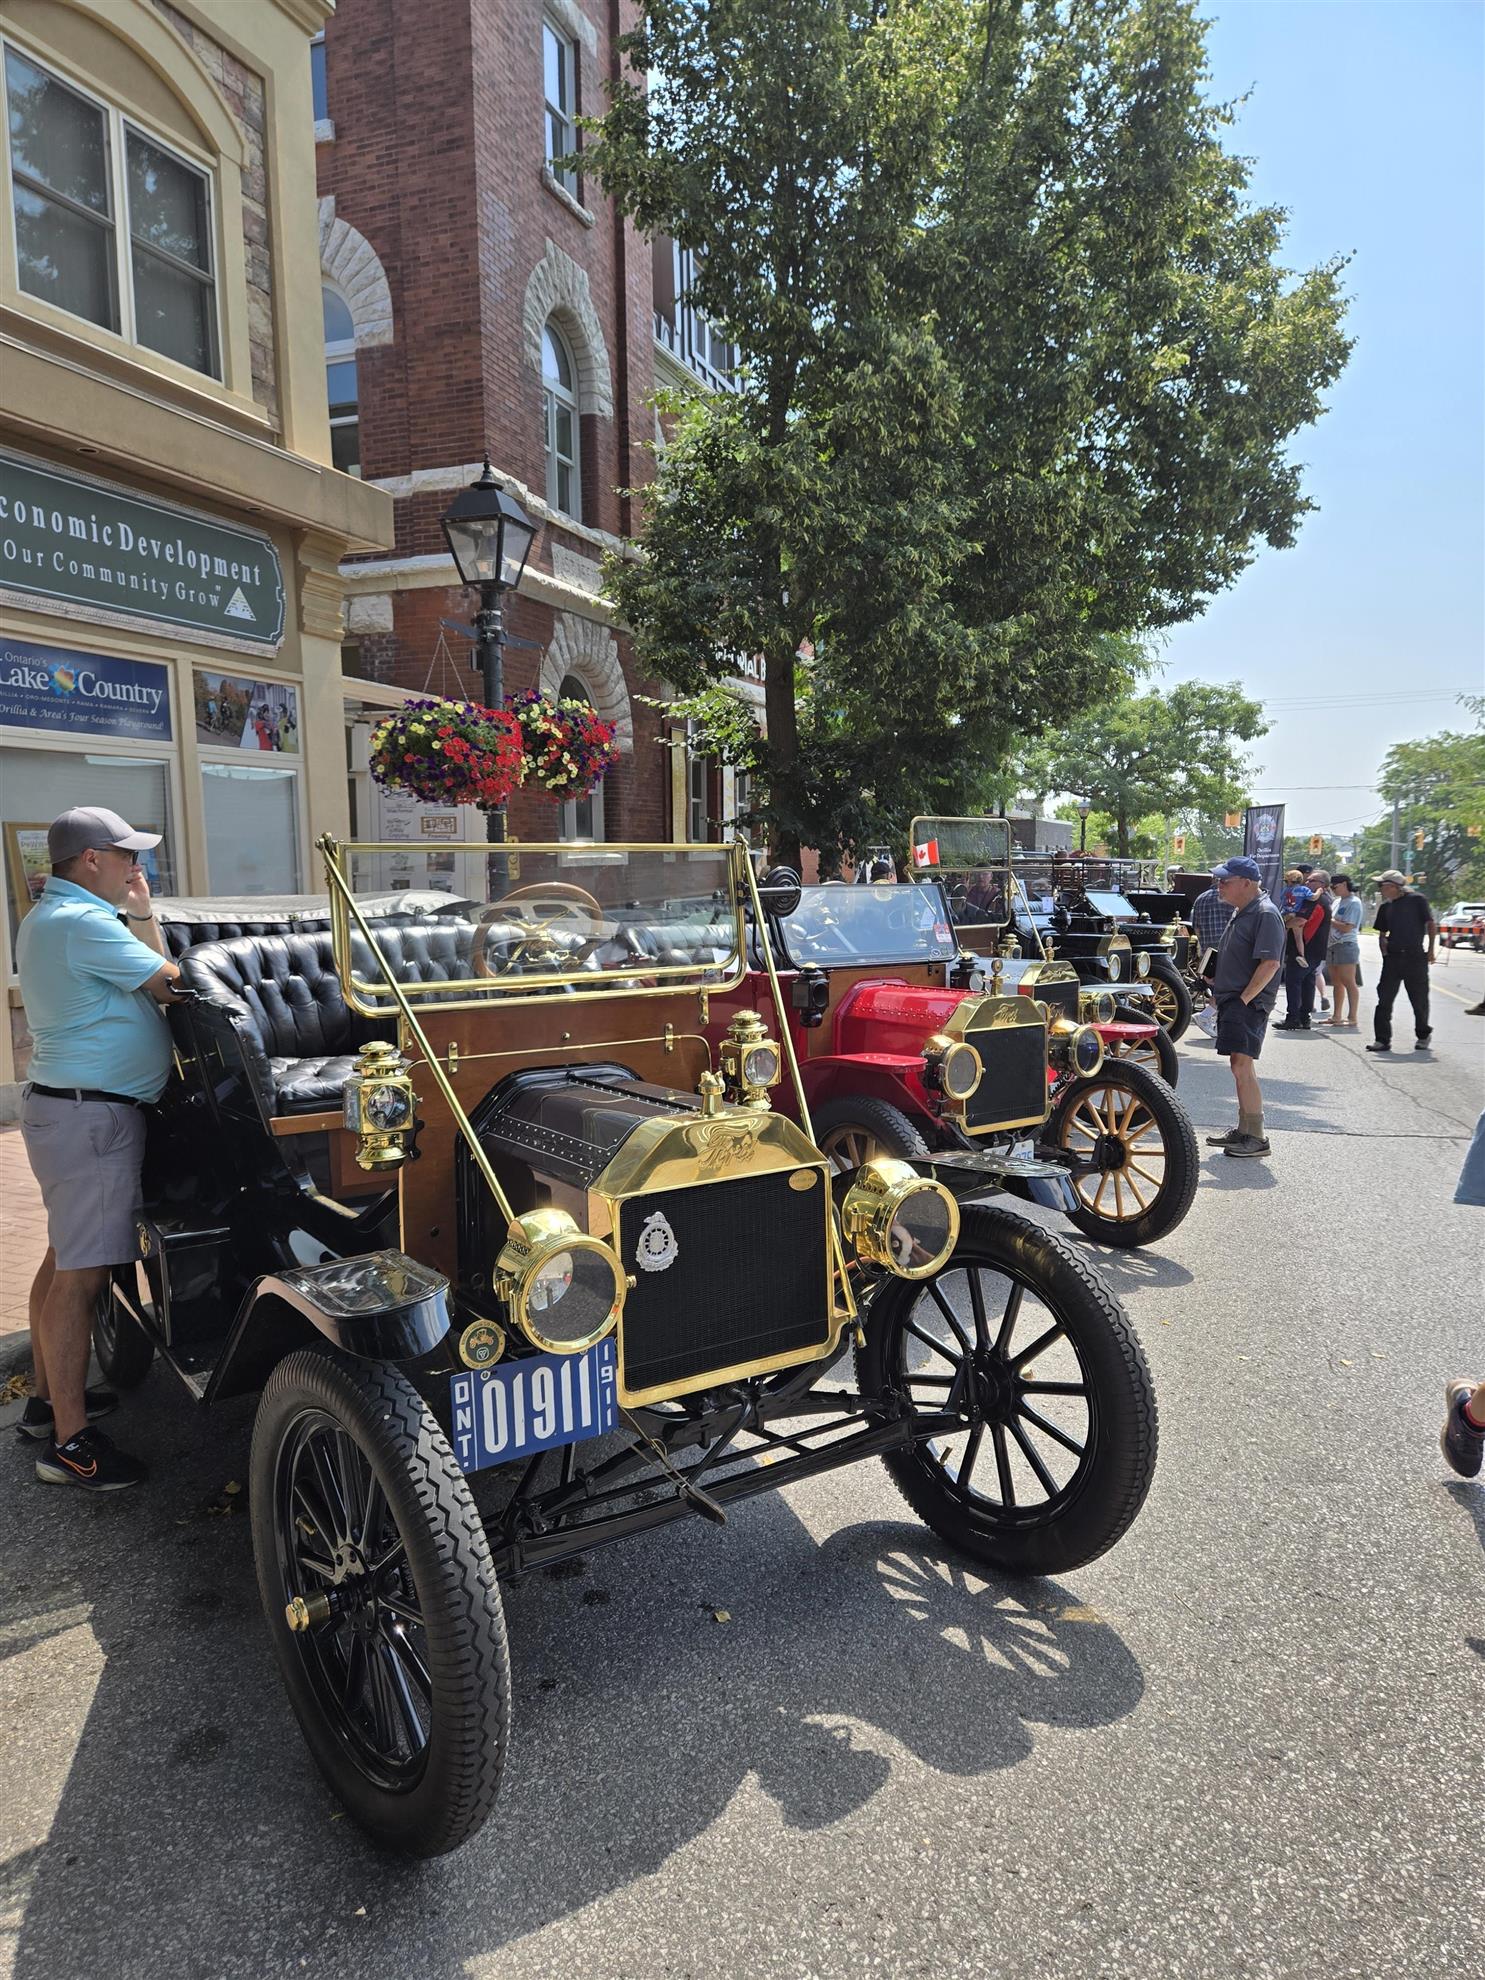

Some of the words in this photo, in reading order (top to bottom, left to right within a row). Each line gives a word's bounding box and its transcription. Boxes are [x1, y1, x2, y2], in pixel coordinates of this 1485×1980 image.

[4, 539, 43, 567] Our
[53, 551, 168, 600] Community
[117, 522, 260, 586] Development
[5, 651, 48, 668] Ontario's
[30, 708, 37, 717] &
[78, 671, 163, 714] Country
[481, 1354, 592, 1454] 01911
[600, 1343, 614, 1427] 1911
[454, 1380, 472, 1468] ONT.
